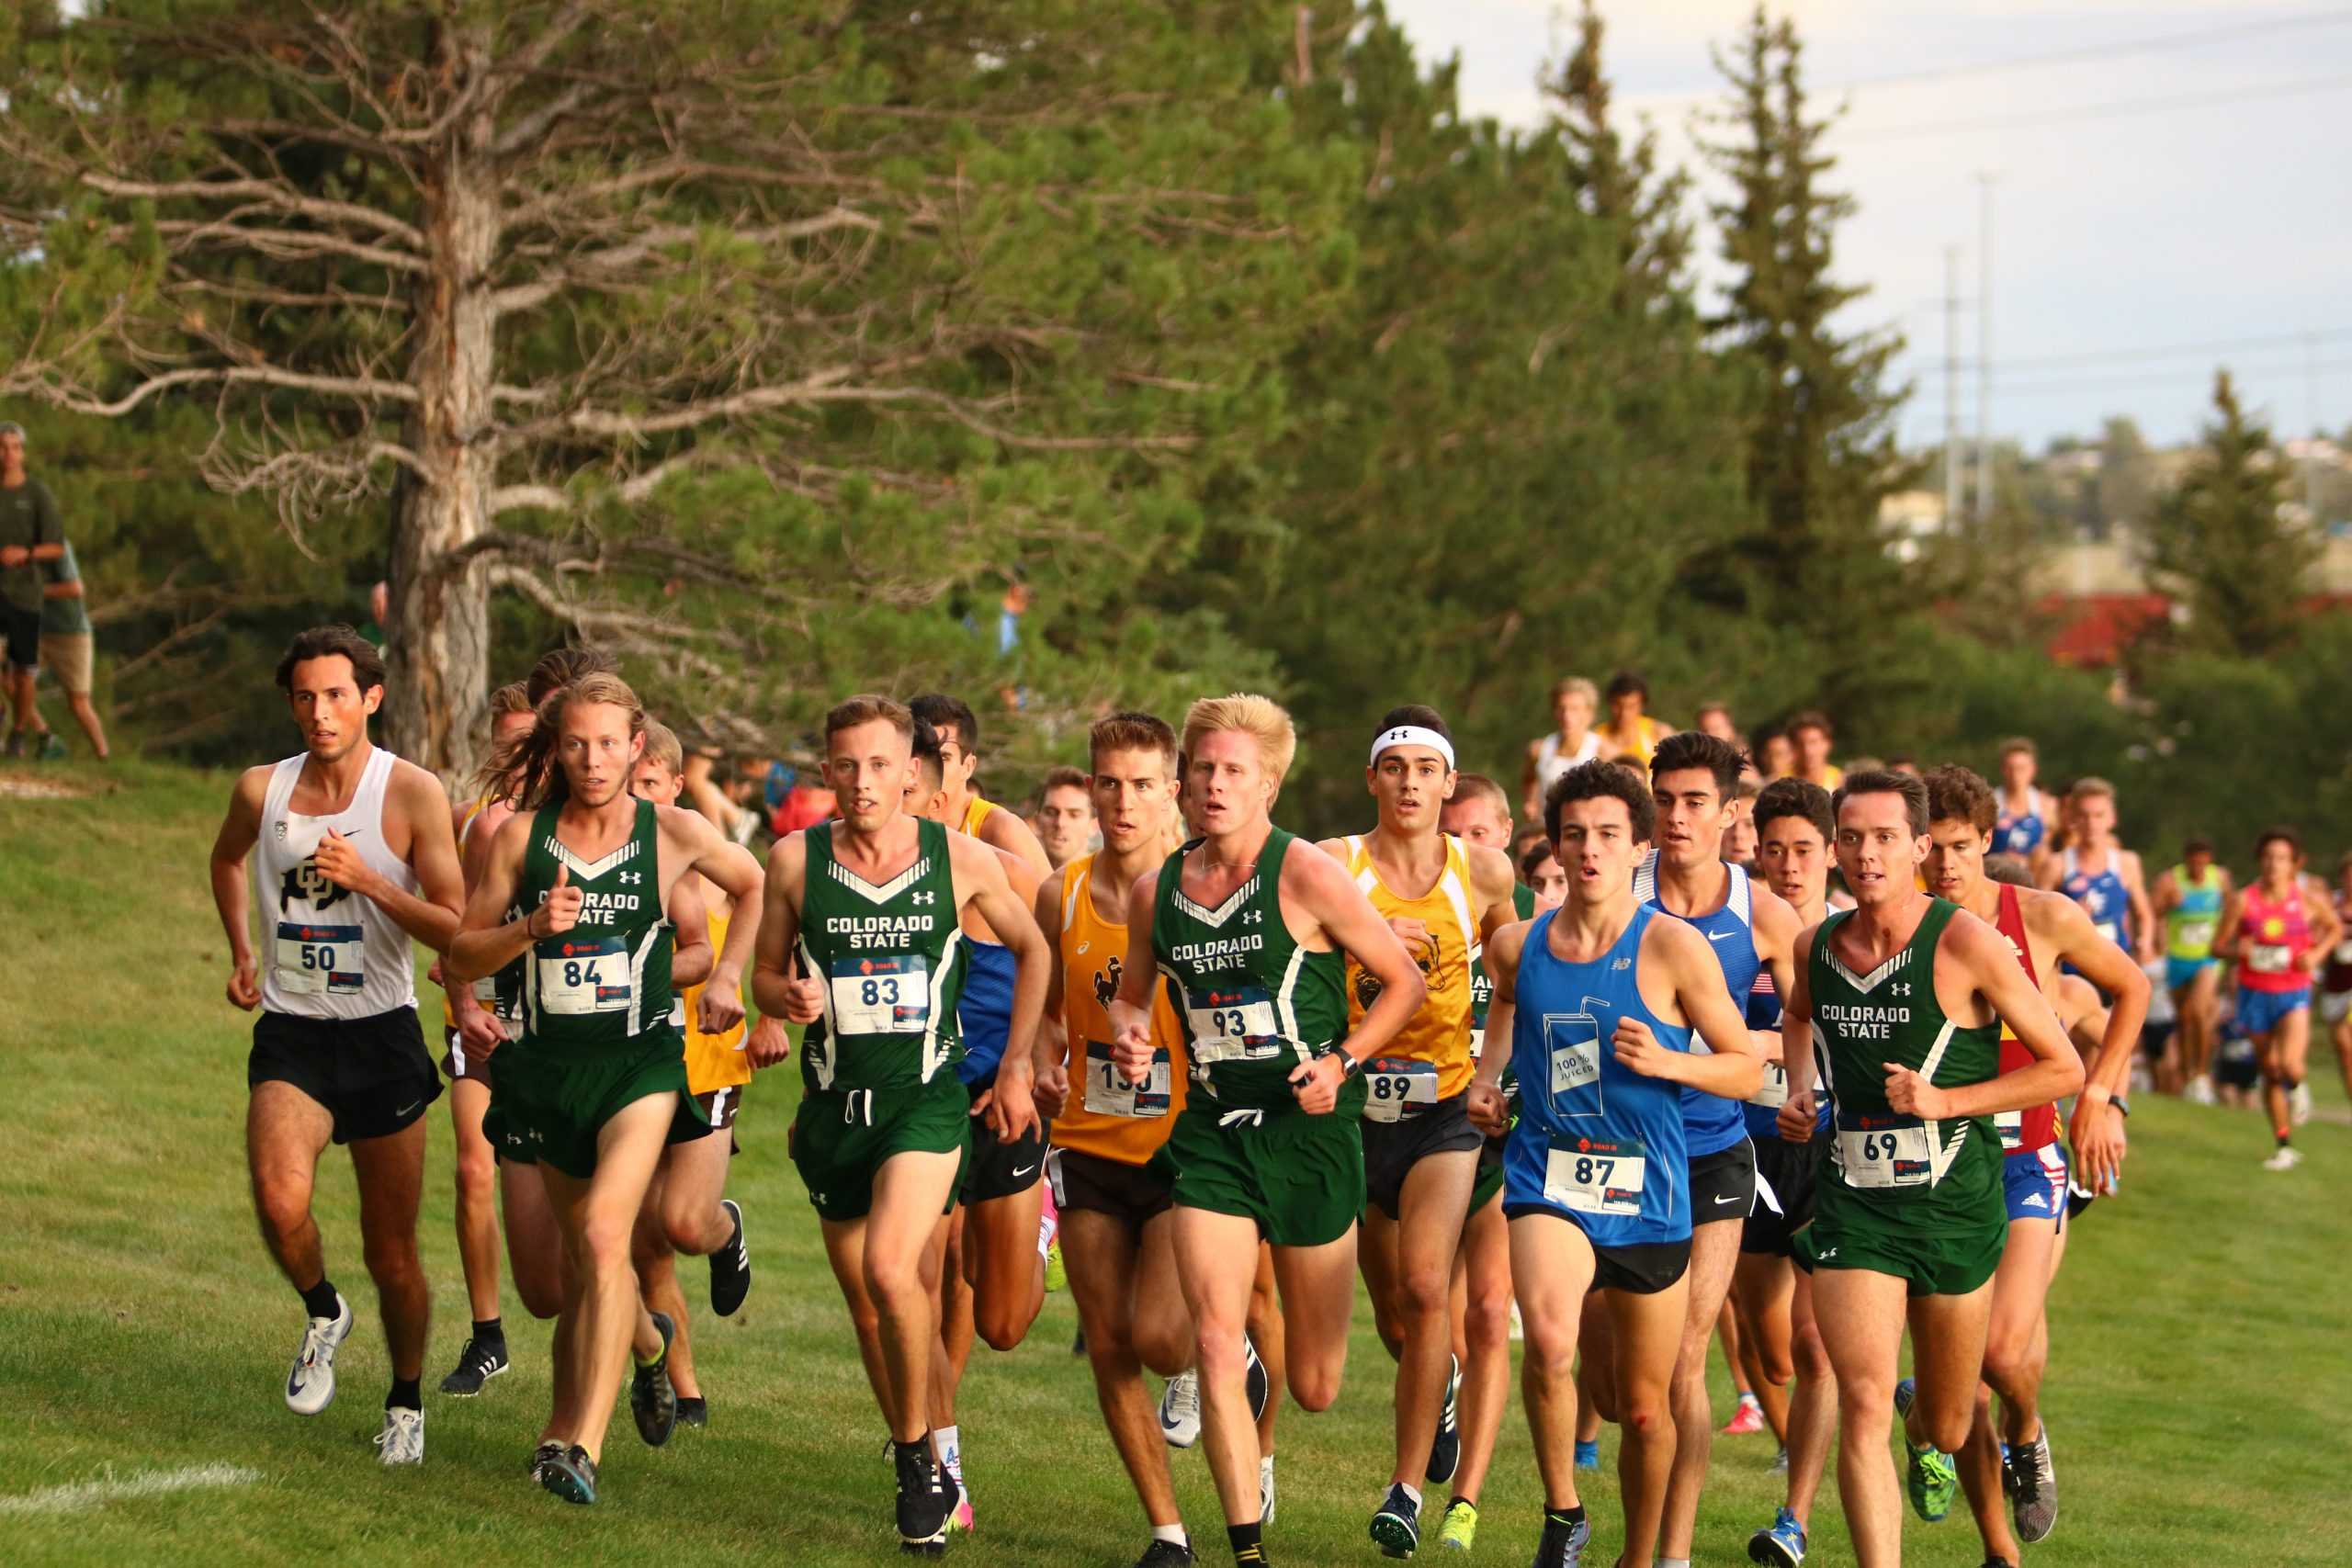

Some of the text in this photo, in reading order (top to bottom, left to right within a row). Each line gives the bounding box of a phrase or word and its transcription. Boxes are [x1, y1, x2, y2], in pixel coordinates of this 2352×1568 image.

[538, 890, 639, 910] CRADO
[579, 908, 616, 925] ATE
[827, 915, 933, 933] COLORADO
[850, 932, 910, 949] STATE
[1171, 933, 1263, 961] COLORADO
[301, 944, 326, 971] 50
[1193, 953, 1246, 975] STATE
[564, 960, 602, 987] 84
[862, 978, 899, 1006] 83
[1213, 1010, 1246, 1037] 93
[1822, 1005, 1910, 1022] COLORADO
[1838, 1022, 1891, 1039] STATE
[1560, 1065, 1594, 1080] JUICED
[1374, 1077, 1410, 1100] 89
[1864, 1133, 1897, 1160] 69
[1575, 1157, 1615, 1186] 87
